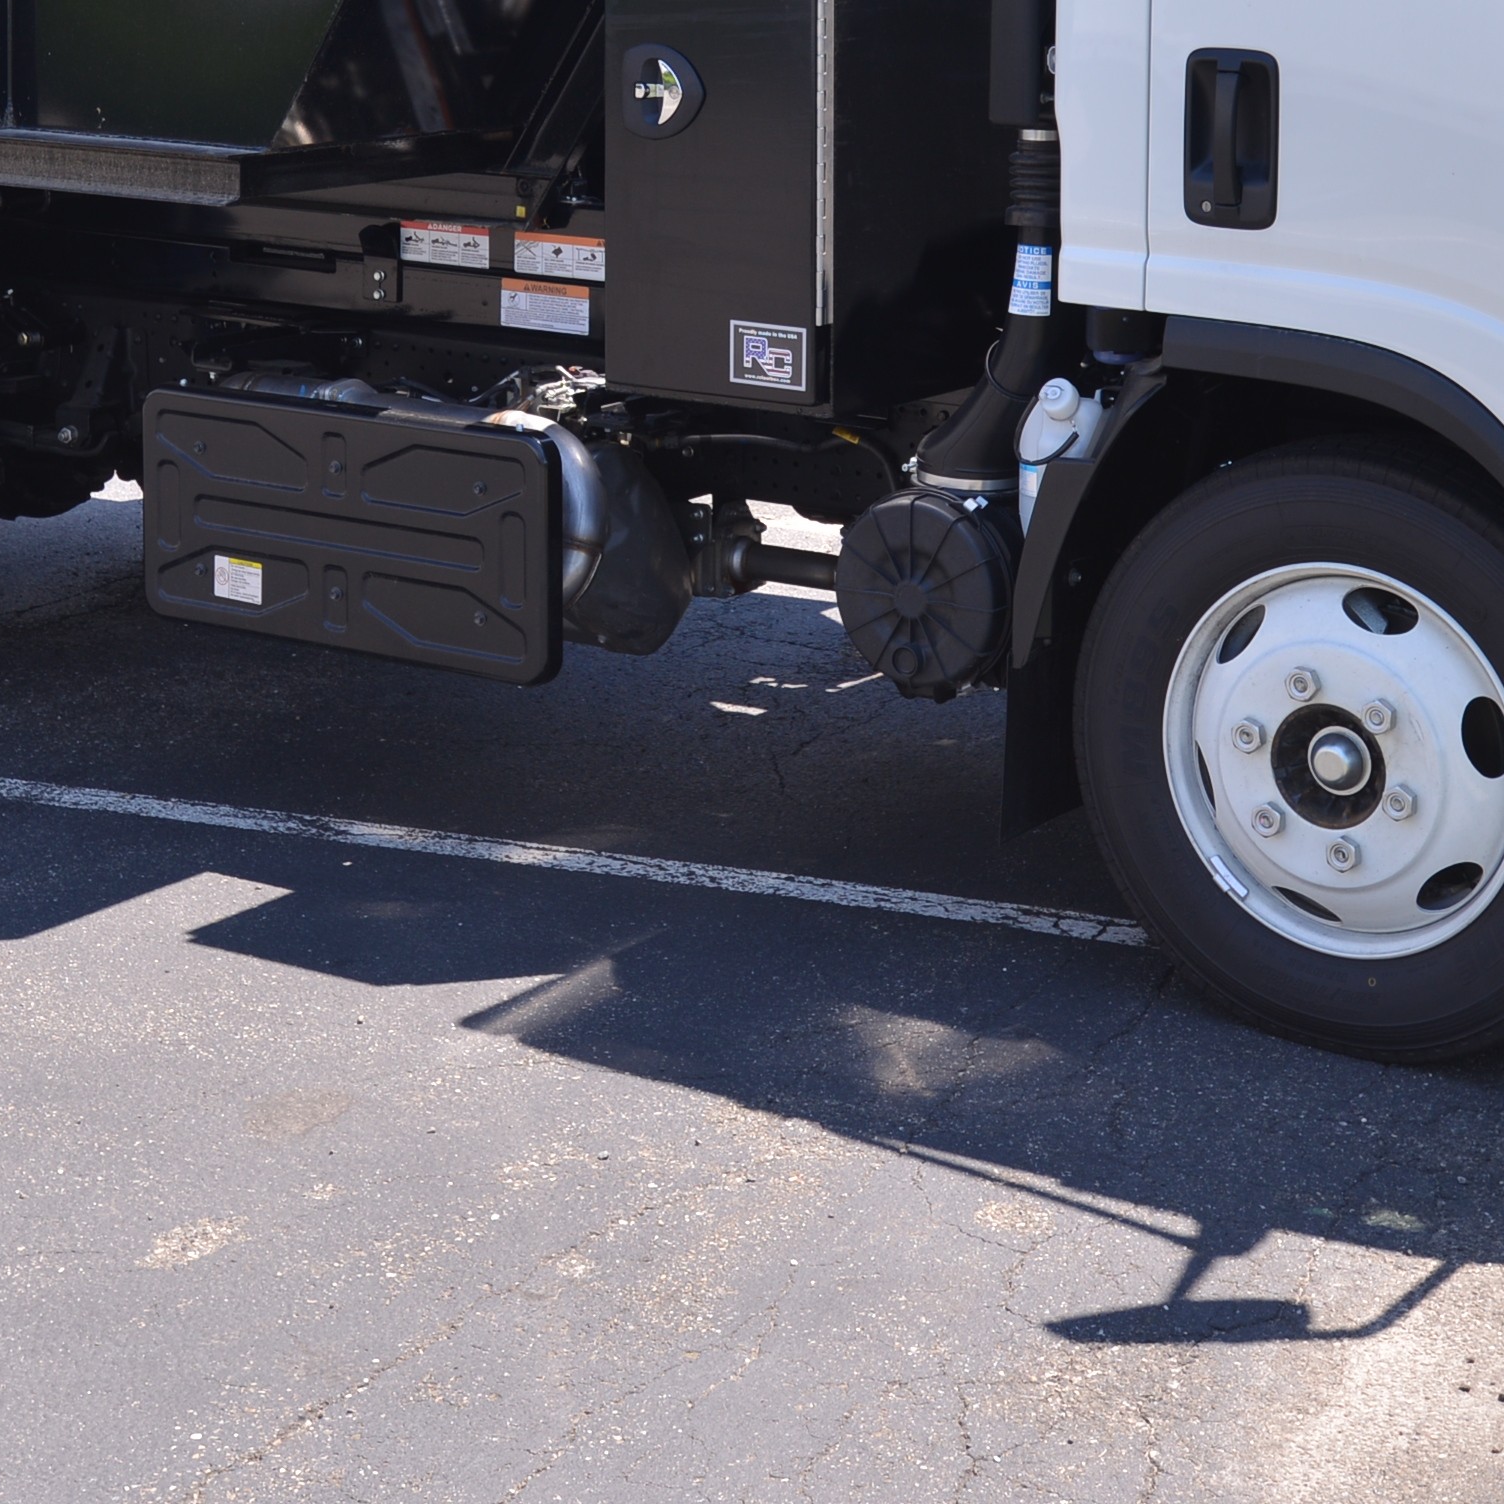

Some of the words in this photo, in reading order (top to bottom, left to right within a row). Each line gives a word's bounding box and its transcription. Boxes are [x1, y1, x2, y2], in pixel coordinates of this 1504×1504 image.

[432, 224, 462, 233] DANGER
[1018, 246, 1047, 255] OTICE
[529, 284, 567, 295] WARNING
[1016, 281, 1039, 289] AVIS
